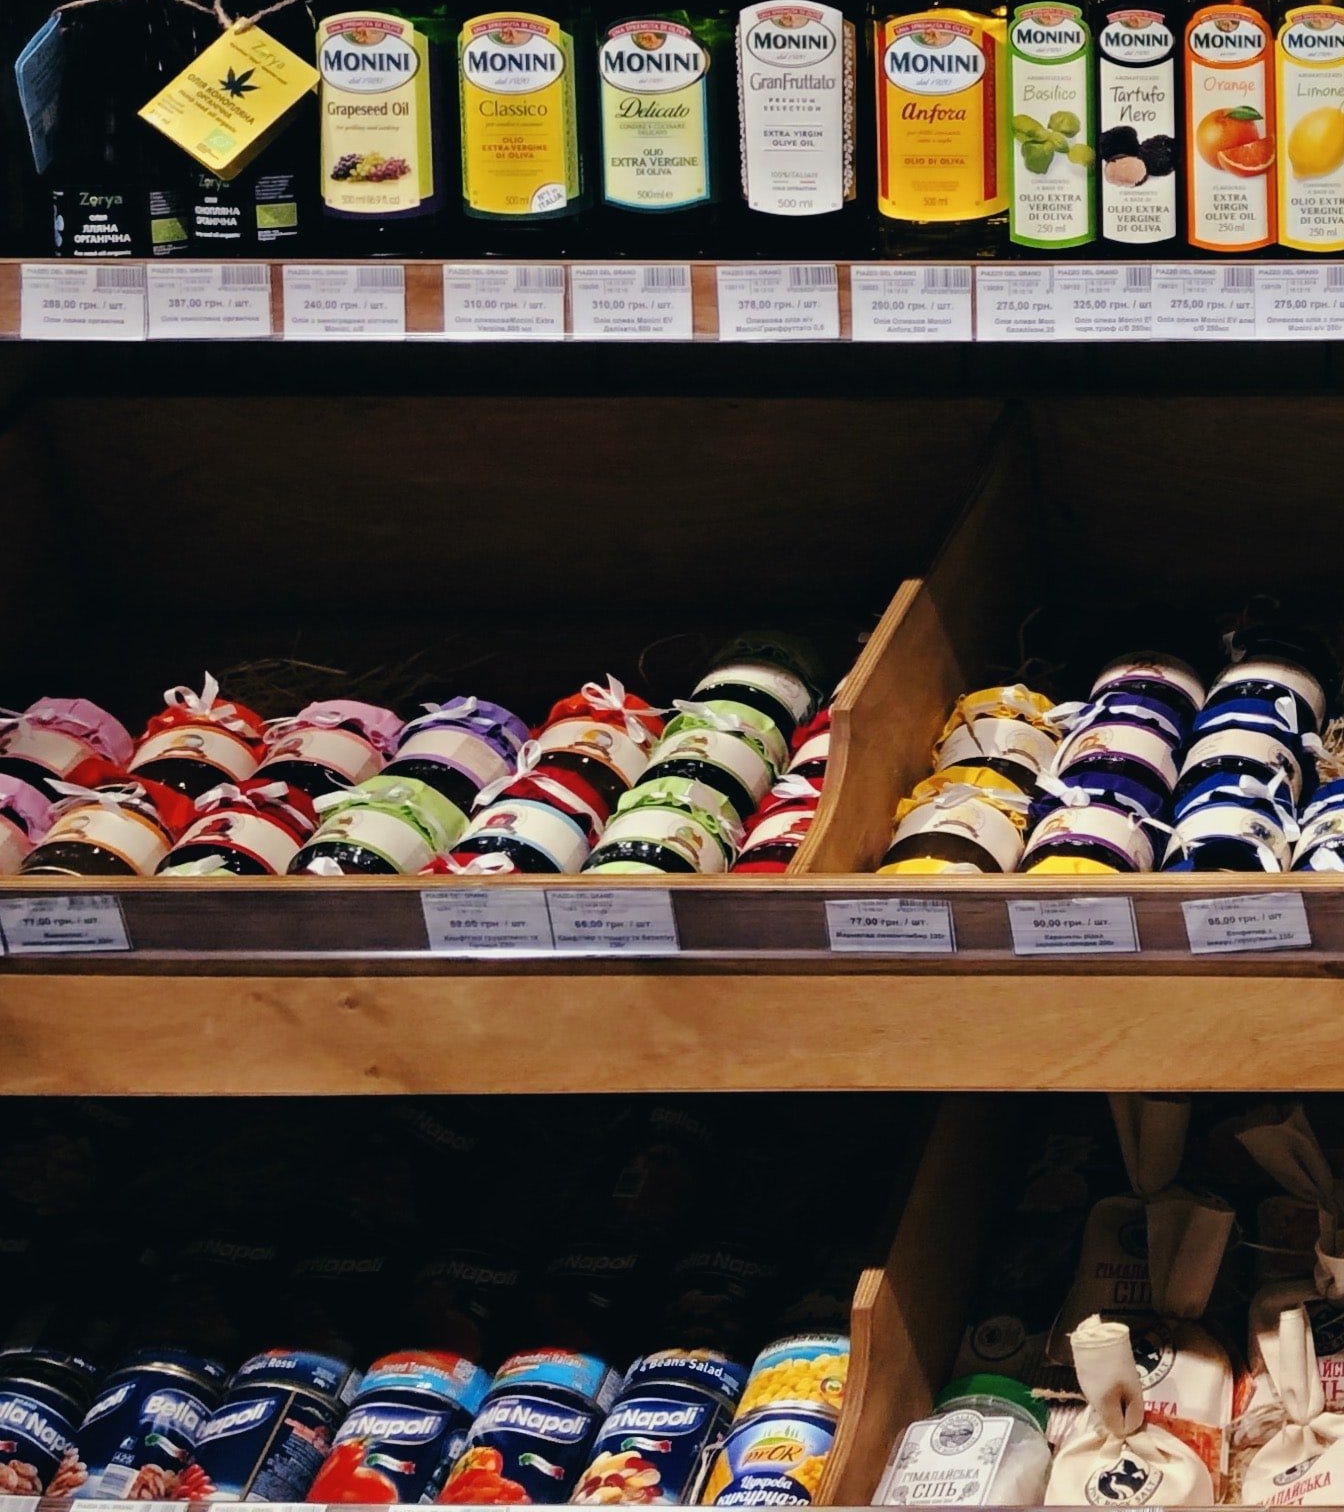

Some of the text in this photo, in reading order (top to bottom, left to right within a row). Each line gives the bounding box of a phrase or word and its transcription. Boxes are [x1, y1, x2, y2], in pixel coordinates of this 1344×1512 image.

[754, 33, 828, 50] MONINI
[325, 52, 410, 72] MONINI
[468, 52, 556, 72] MONINI
[605, 51, 700, 72] MONINI
[890, 52, 979, 74] MONINI
[751, 73, 834, 91] GranFruttato
[1204, 76, 1256, 95] Orange
[1297, 82, 1344, 97] Limone
[1024, 85, 1076, 101] Basilico
[1110, 87, 1165, 103] Tartufo
[328, 101, 409, 118] Grapeseed Oil
[479, 100, 548, 117] Classico
[616, 99, 689, 118] Delicato
[902, 102, 966, 121] Anfora
[1120, 106, 1156, 122] Nero
[80, 193, 122, 207] Zorya
[1214, 194, 1247, 202] EXTRA
[1205, 212, 1256, 221] OLIVE OIL
[649, 1359, 723, 1377] Beans Salad
[511, 1408, 584, 1437] Napoli
[619, 1408, 696, 1429] Napoli
[912, 1483, 957, 1499] СІЛЬ
